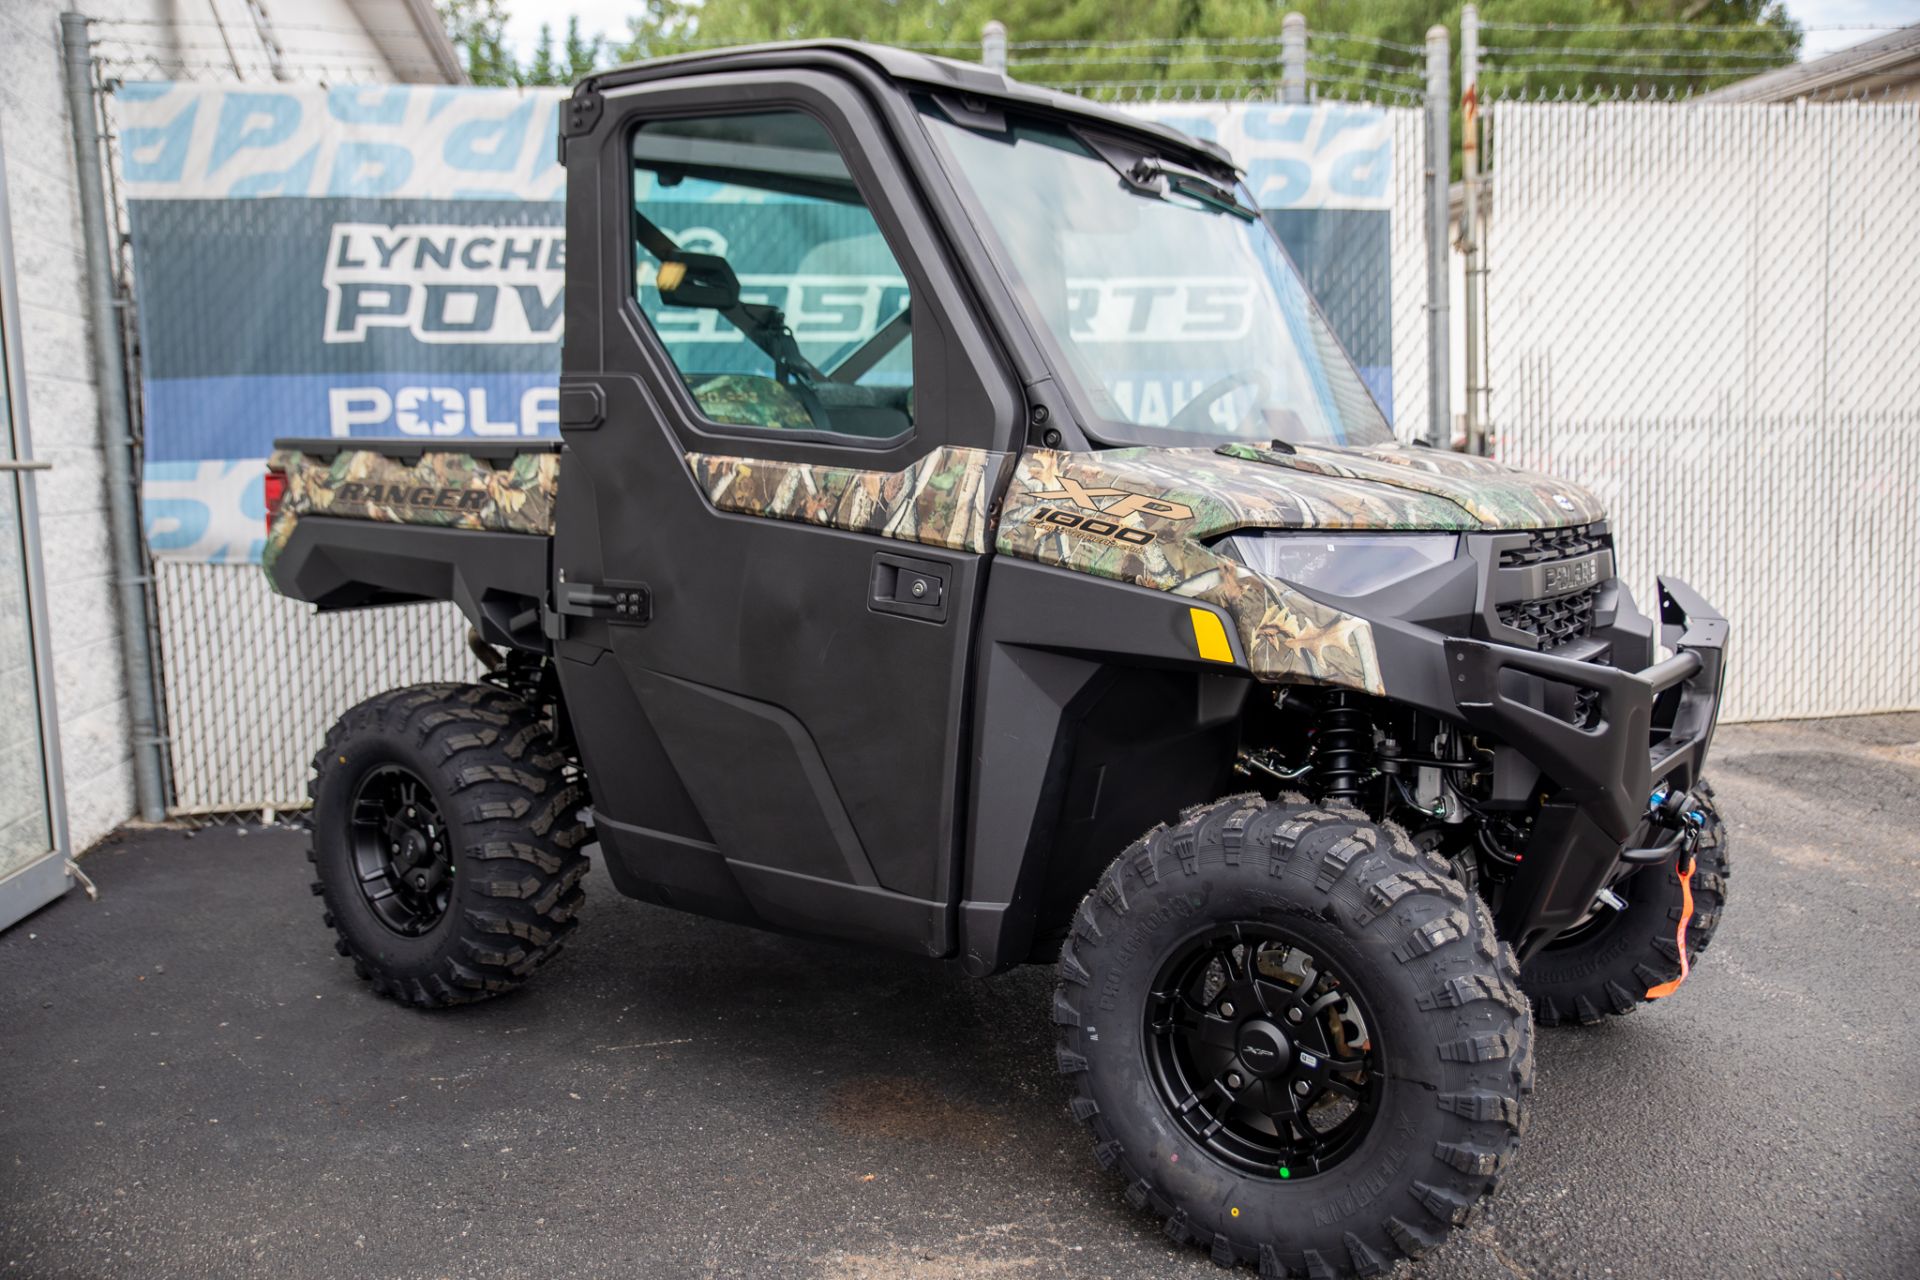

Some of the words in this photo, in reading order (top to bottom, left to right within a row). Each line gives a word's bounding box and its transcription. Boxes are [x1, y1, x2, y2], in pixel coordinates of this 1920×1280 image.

[339, 481, 487, 510] RANGER
[1019, 475, 1195, 520] XP
[1032, 506, 1157, 546] 1000
[1242, 1045, 1274, 1056] XP
